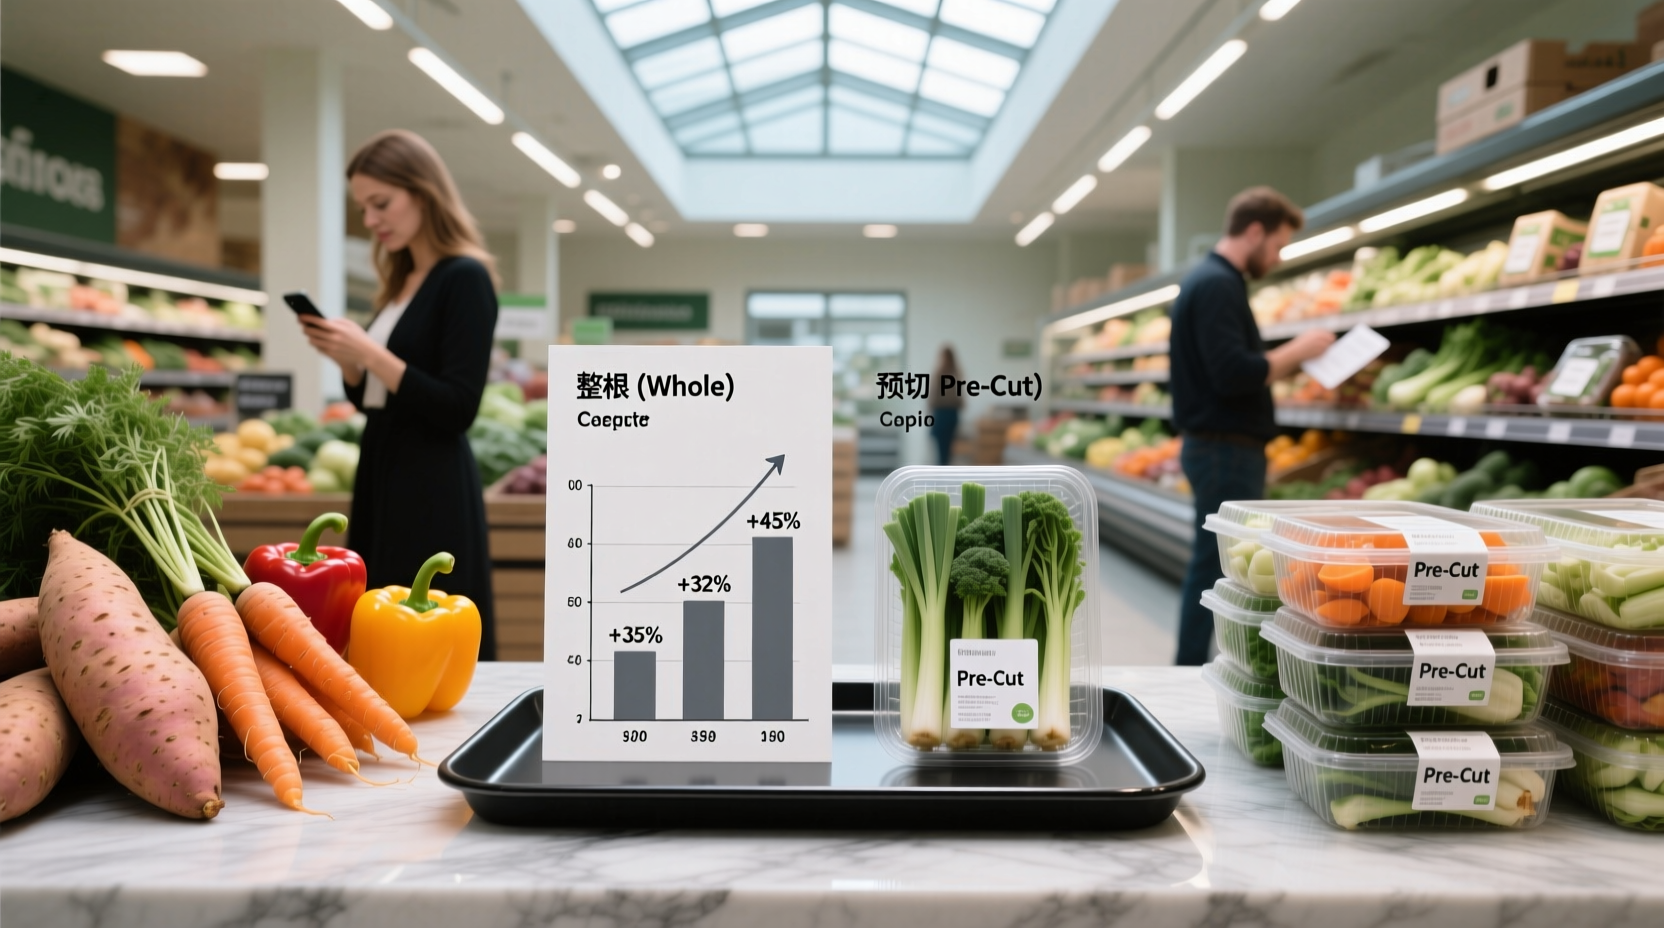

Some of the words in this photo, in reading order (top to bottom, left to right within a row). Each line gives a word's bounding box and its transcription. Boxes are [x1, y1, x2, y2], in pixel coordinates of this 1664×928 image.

[576, 371, 629, 400] 整根
[637, 372, 734, 402] (Whole)
[746, 511, 801, 530] +45%
[1414, 561, 1480, 578] Pre-Cut
[677, 574, 732, 593] +32%
[608, 625, 663, 644] +35%
[957, 669, 1025, 687] Pre-Cut
[1419, 662, 1487, 679] Pre-Cut
[1423, 767, 1491, 784] Pre-Cut
